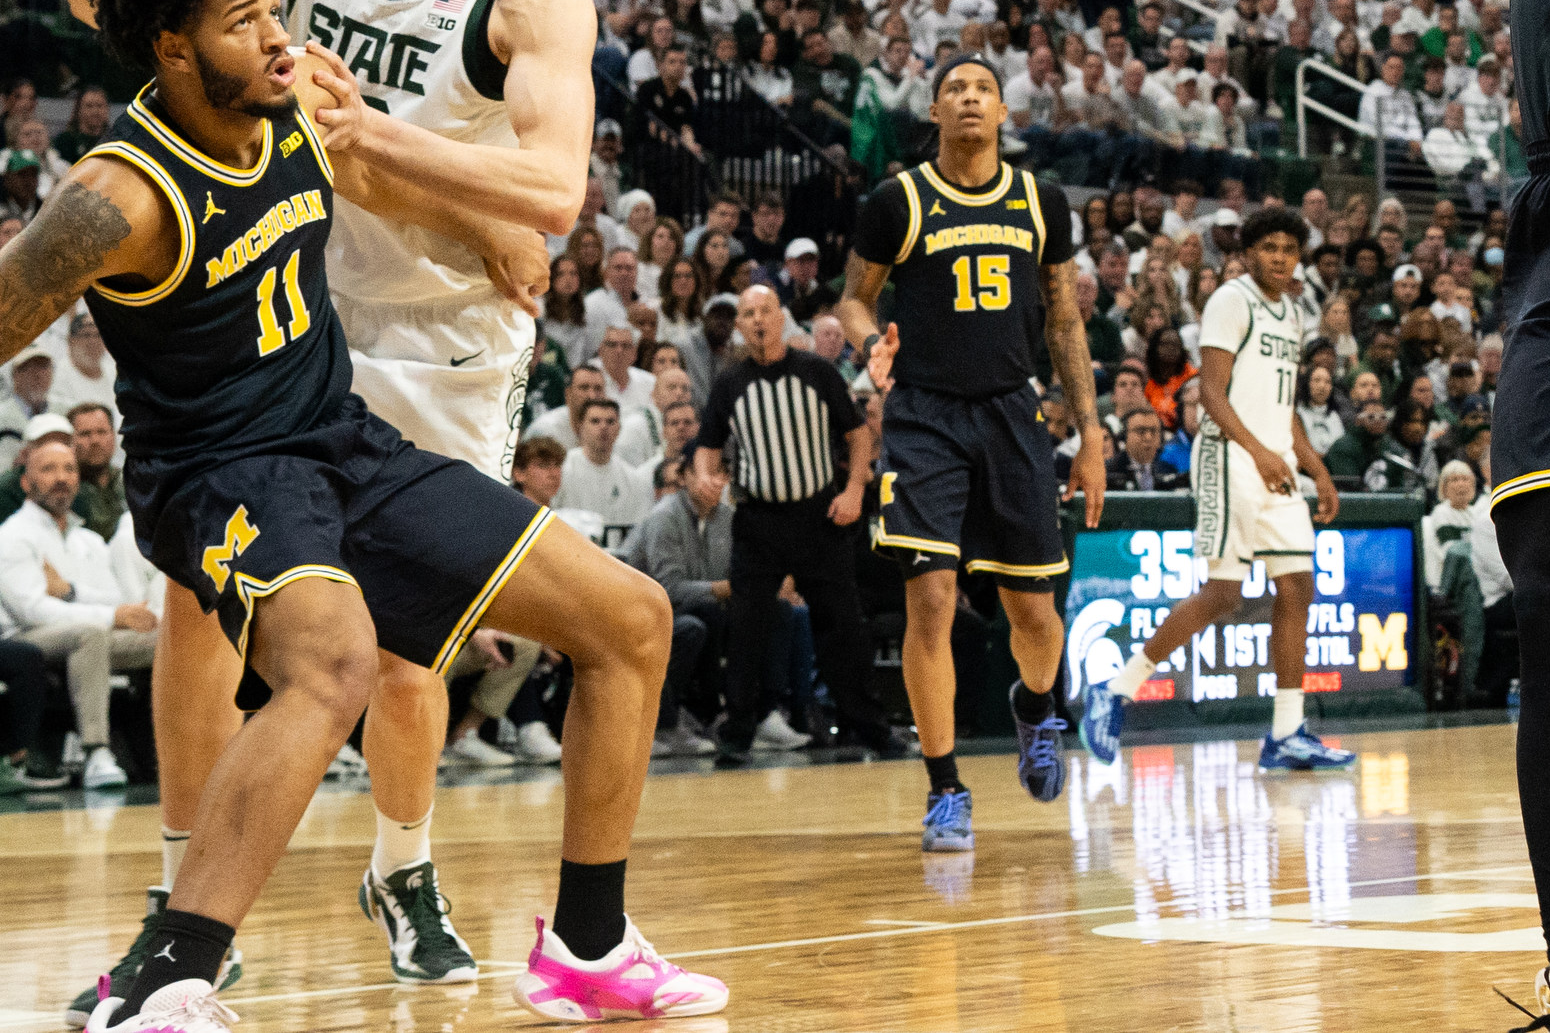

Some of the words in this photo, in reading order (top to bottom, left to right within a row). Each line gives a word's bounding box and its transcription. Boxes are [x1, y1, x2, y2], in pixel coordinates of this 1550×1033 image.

[307, 2, 442, 97] STATE
[206, 189, 327, 289] MICHIGAN
[925, 224, 1034, 255] MICHIGAN
[257, 249, 311, 357] 11
[952, 254, 1012, 312] 15
[1276, 368, 1292, 406] 11
[202, 504, 261, 595] M
[1130, 530, 1194, 599] 35
[1223, 623, 1273, 667] 1ST
[1358, 612, 1408, 672] M
